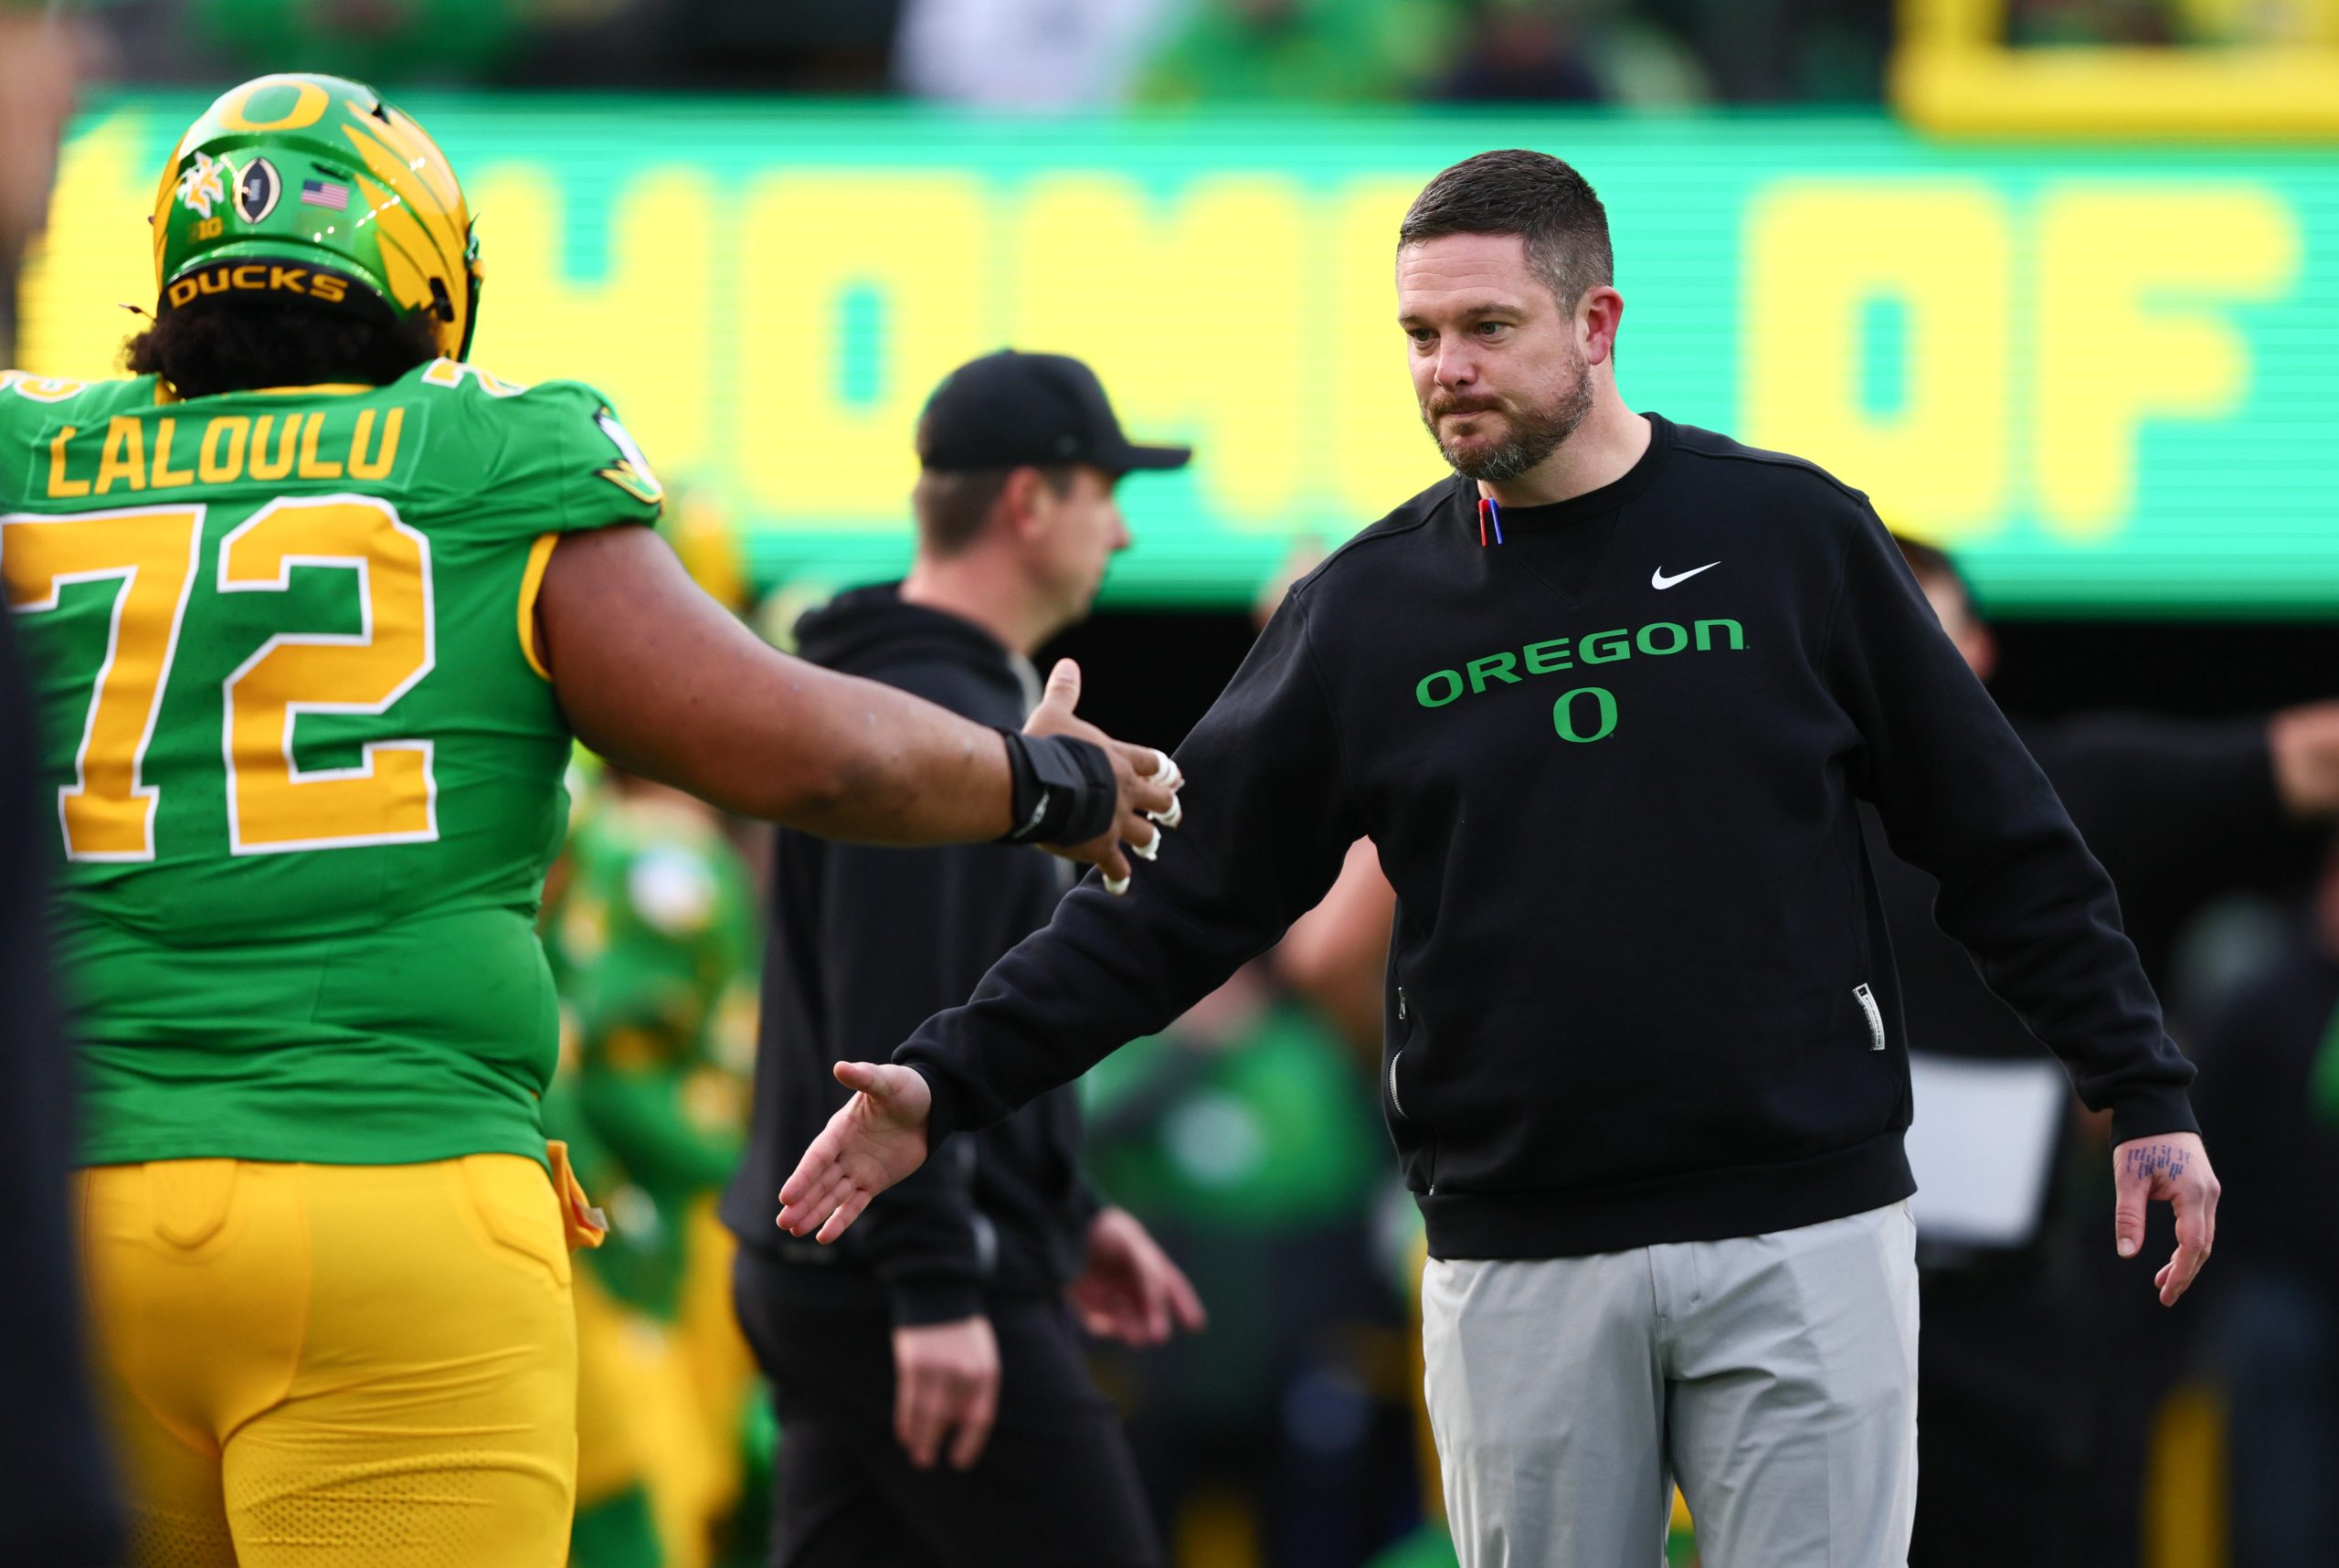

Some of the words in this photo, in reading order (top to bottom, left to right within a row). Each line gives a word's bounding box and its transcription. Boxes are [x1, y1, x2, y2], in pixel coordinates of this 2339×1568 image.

[167, 265, 349, 309] DUCKS
[1736, 174, 2304, 546] OF
[47, 407, 405, 498] LALOULU
[0, 493, 439, 863] 72
[1415, 619, 1744, 708] OREGON
[1553, 686, 1618, 743] O
